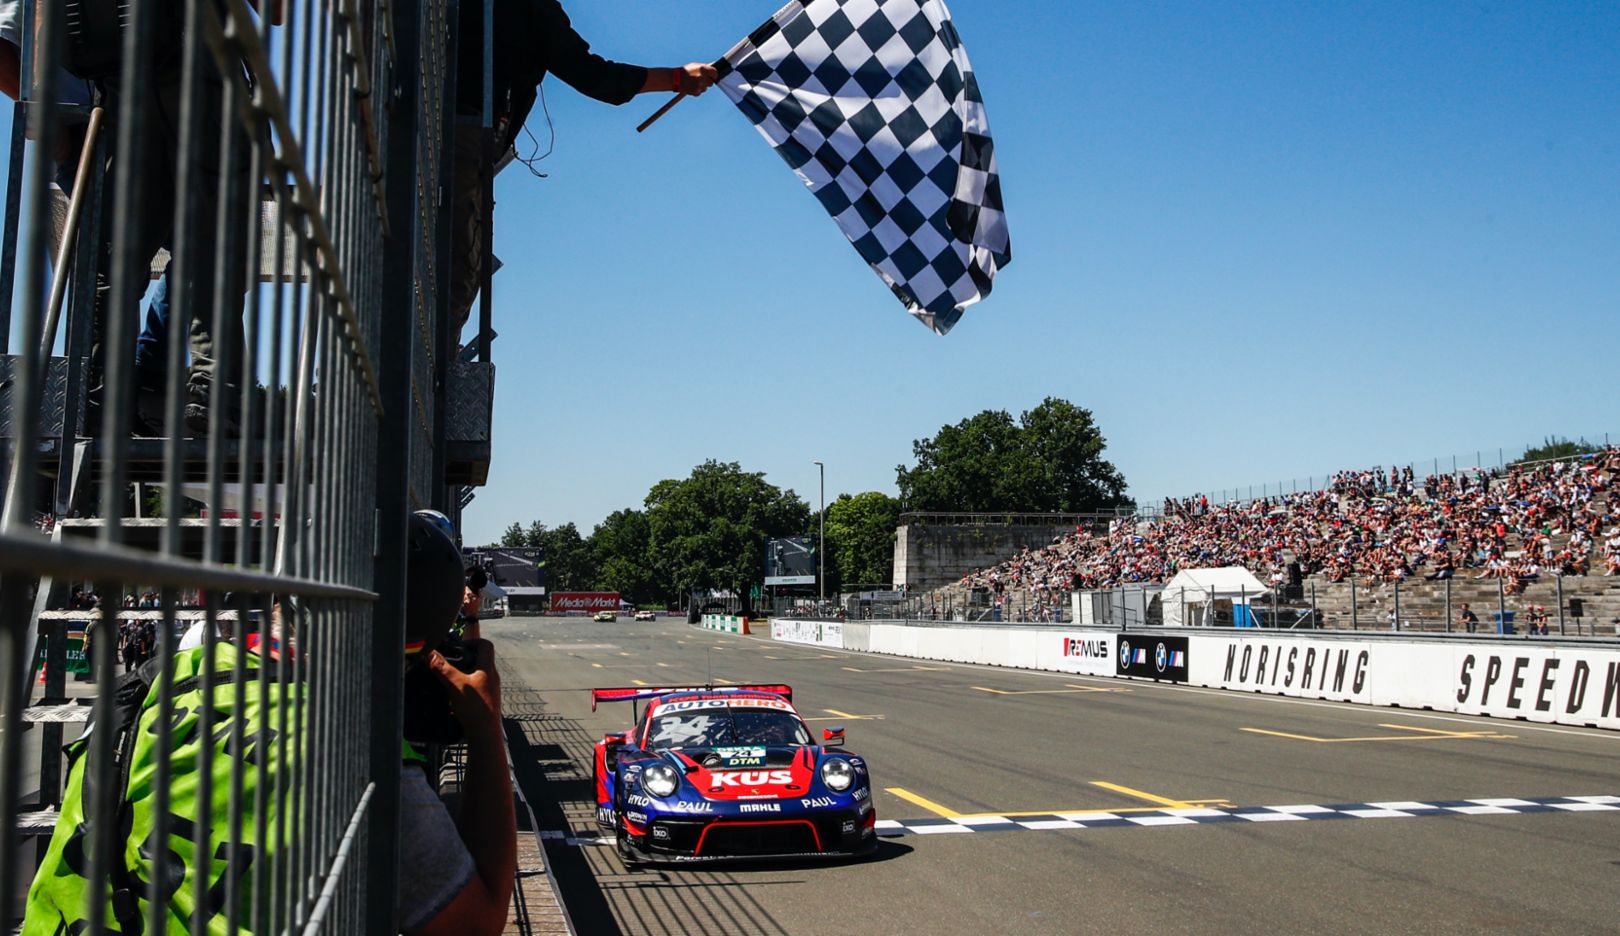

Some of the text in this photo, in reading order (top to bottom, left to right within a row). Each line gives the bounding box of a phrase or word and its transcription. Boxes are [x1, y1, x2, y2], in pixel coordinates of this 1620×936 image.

[1064, 638, 1107, 658] REMUS
[1223, 644, 1369, 694] NORISRING
[661, 700, 787, 713] AUTOHERO
[729, 757, 761, 766] DTM
[710, 771, 793, 787] KÜS
[628, 794, 650, 807] HYLO
[677, 801, 713, 813] PAUL
[801, 797, 837, 808] PAUL
[740, 803, 781, 813] MAHLE
